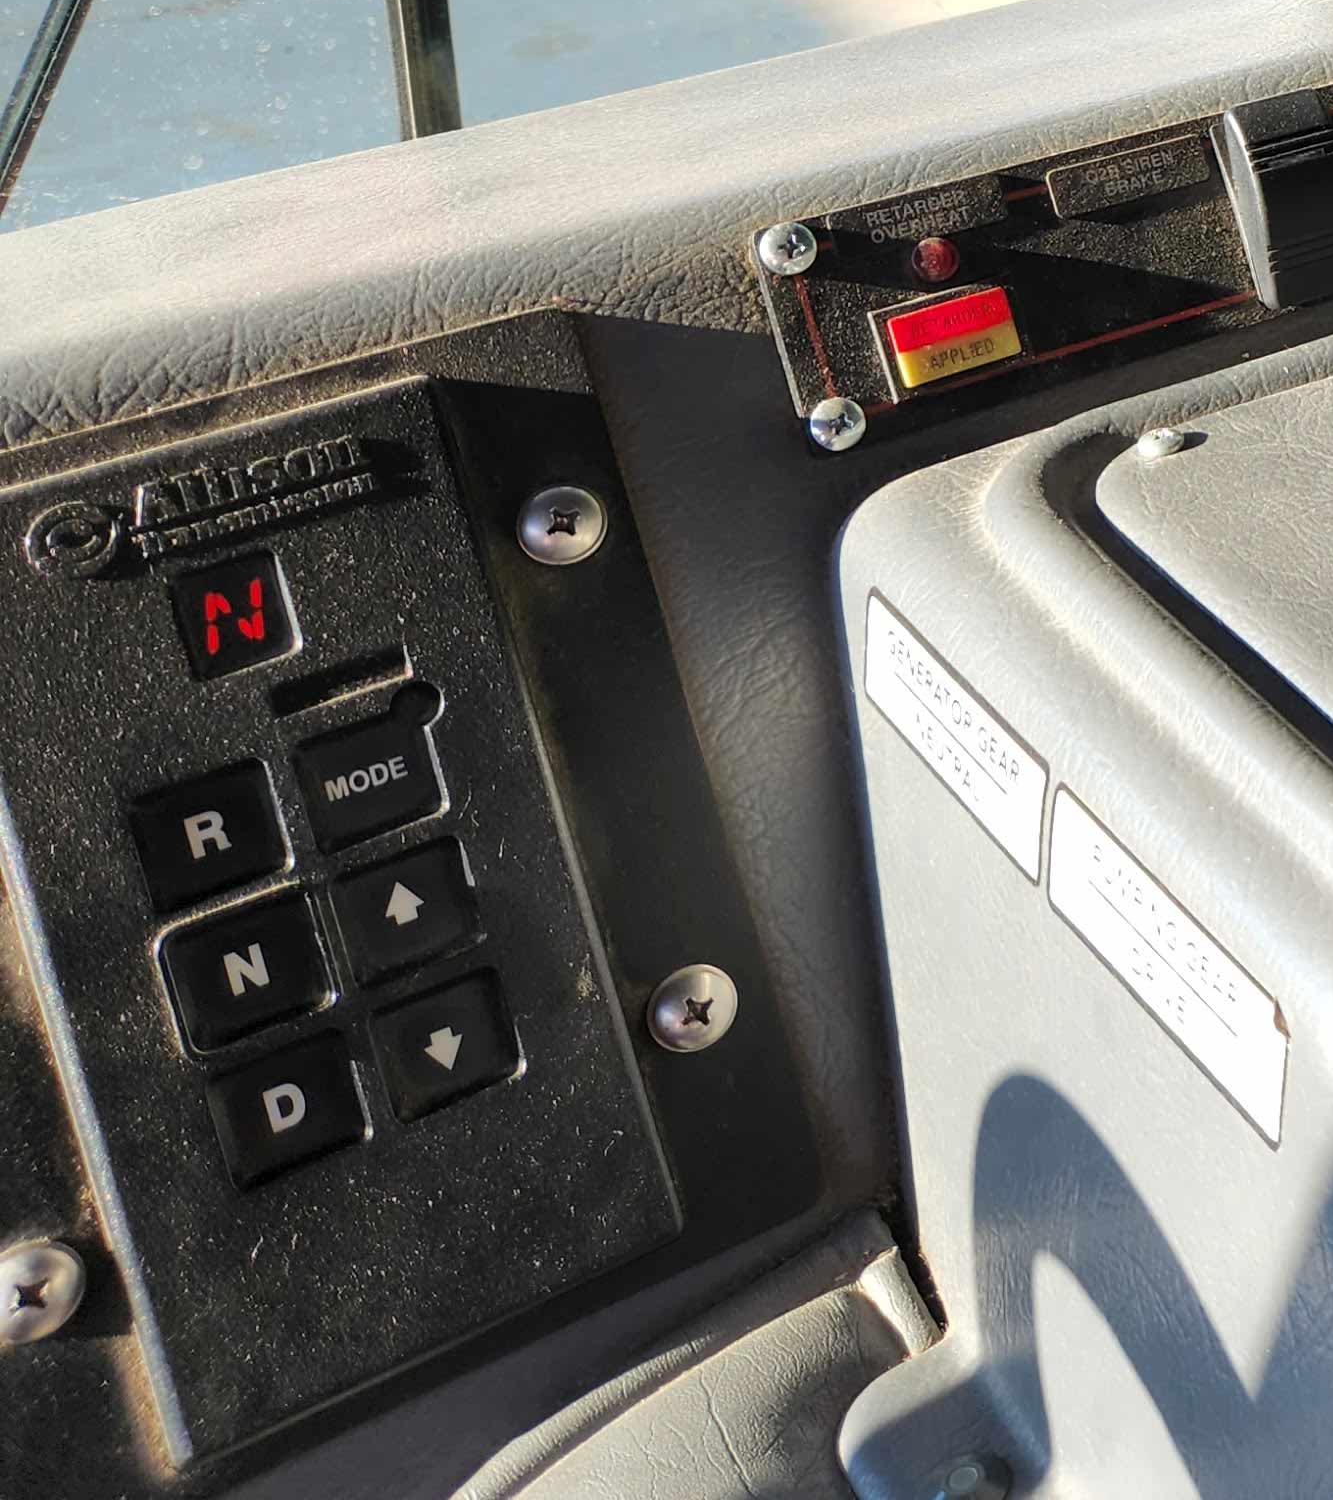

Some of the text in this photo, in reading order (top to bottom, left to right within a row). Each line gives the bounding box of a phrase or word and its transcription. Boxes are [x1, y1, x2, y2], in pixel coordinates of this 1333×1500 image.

[1105, 169, 1164, 198] BRAKE
[1124, 149, 1175, 175] SIREN
[864, 189, 968, 228] RETARDER
[869, 206, 972, 245] OVERHEAT
[927, 338, 996, 371] APPLIED
[201, 574, 267, 657] N
[886, 629, 1021, 784] GENERATOR GEAR
[324, 753, 411, 804] MODE
[184, 809, 233, 863] R
[222, 941, 273, 997] N
[262, 1081, 308, 1136] D
